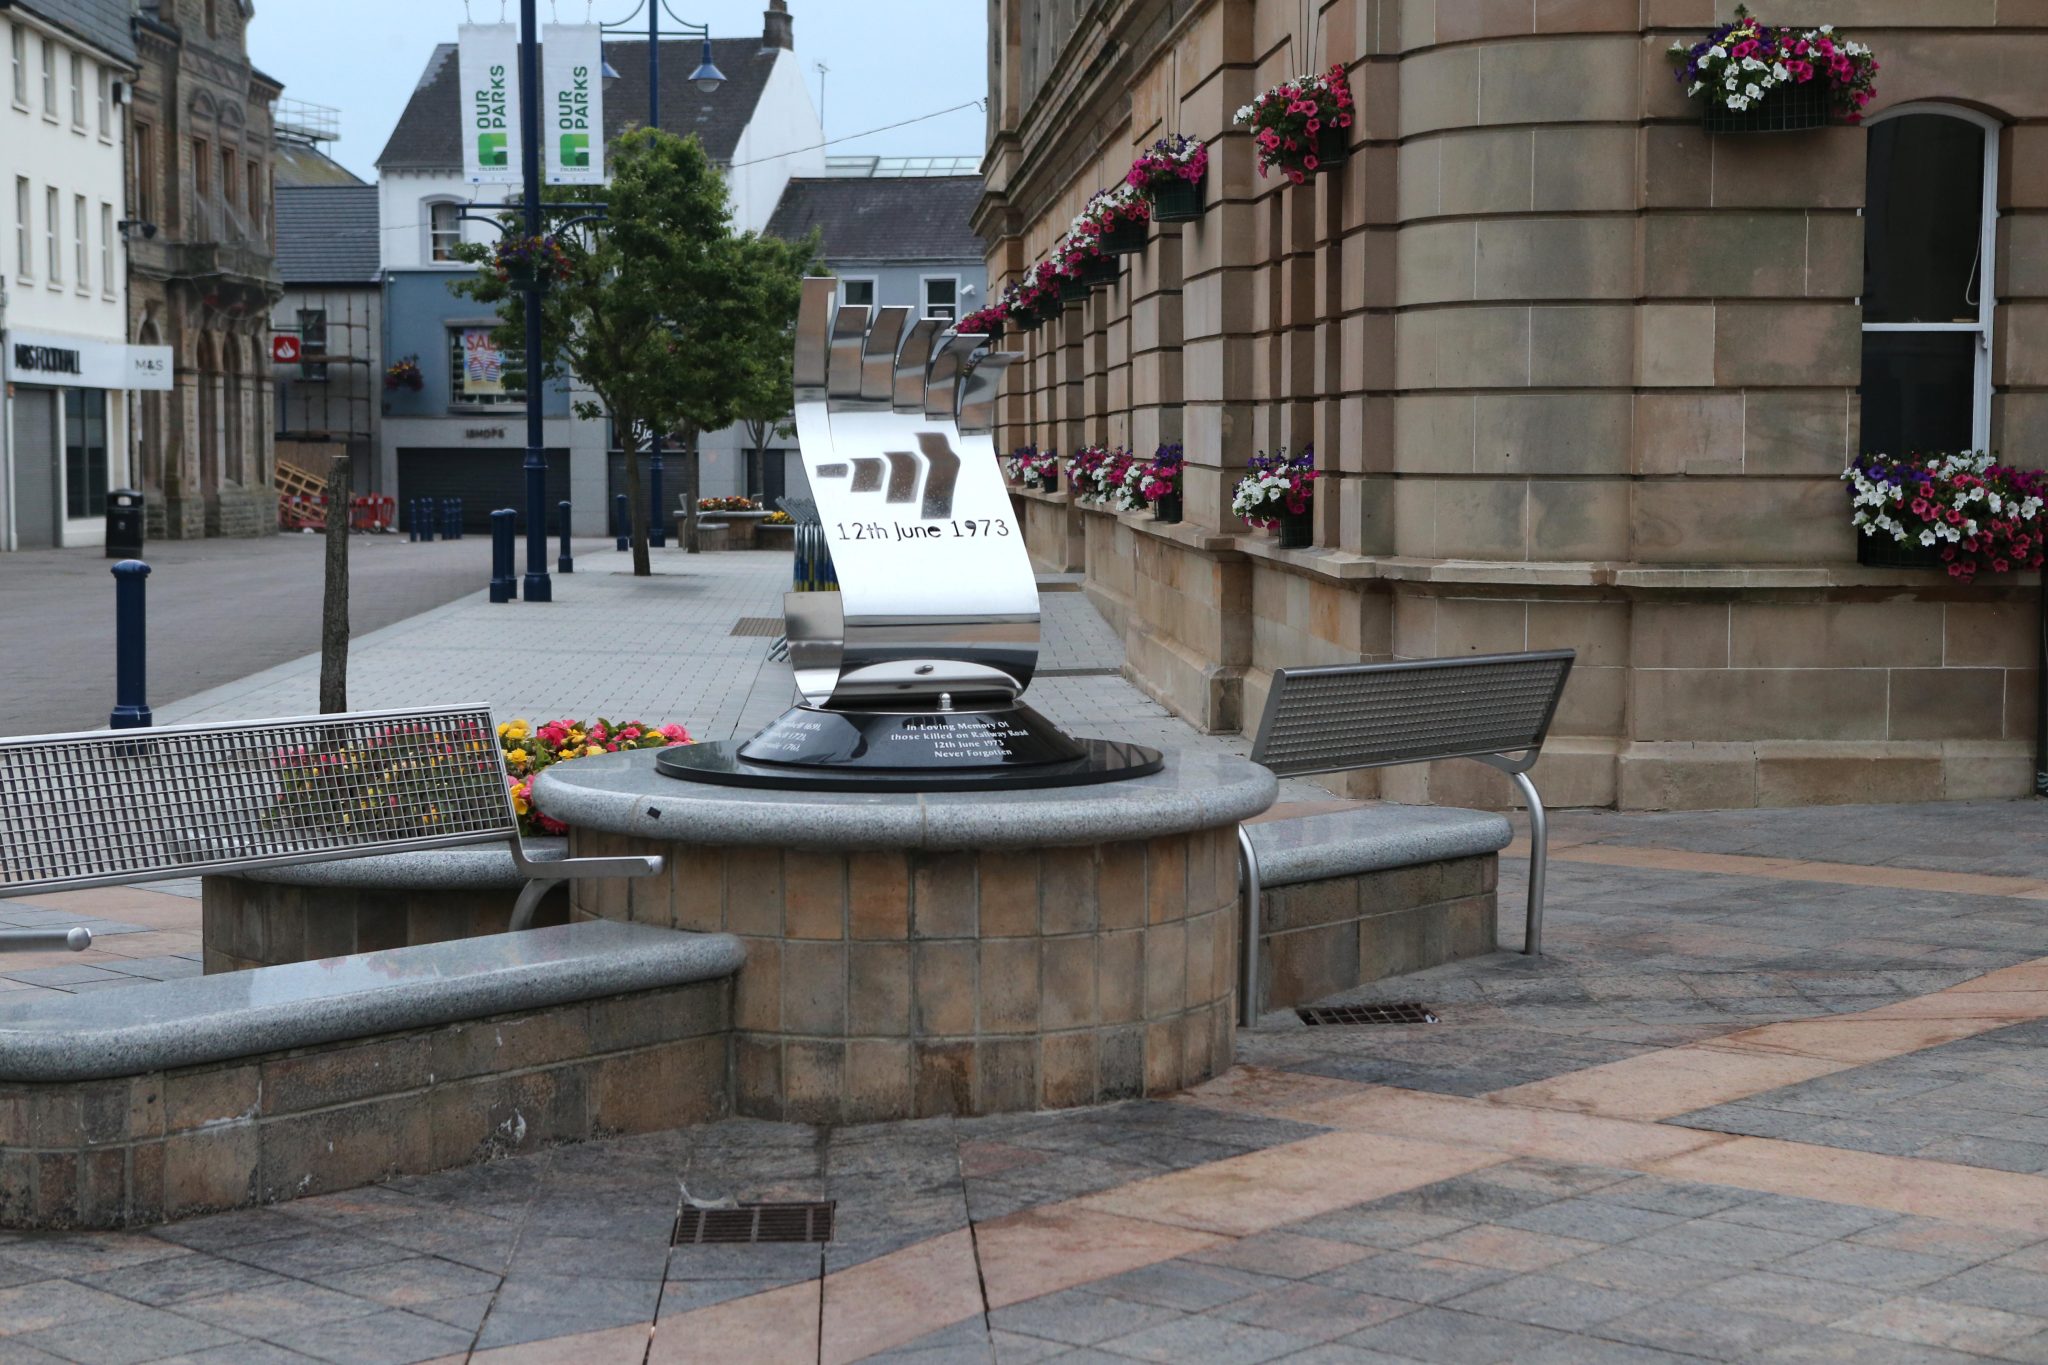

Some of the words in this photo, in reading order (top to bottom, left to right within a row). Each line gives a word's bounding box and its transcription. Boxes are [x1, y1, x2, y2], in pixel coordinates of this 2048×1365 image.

[490, 65, 507, 128] PARKS
[574, 66, 589, 129] PARKS
[476, 90, 491, 129] OUR
[559, 91, 573, 129] OUR
[466, 334, 503, 351] SAL
[136, 358, 164, 372] M&S
[837, 521, 888, 540] 12th
[895, 521, 942, 541] June
[951, 519, 1009, 538] 1973
[920, 723, 956, 732] Loving
[957, 721, 996, 731] Memory
[923, 732, 953, 740] killed
[971, 730, 1007, 739] Railway
[1007, 729, 1029, 737] Road
[934, 741, 956, 749] 12th
[984, 739, 1005, 747] 1973
[934, 750, 965, 758] Never
[966, 749, 1013, 758] Forgotten
